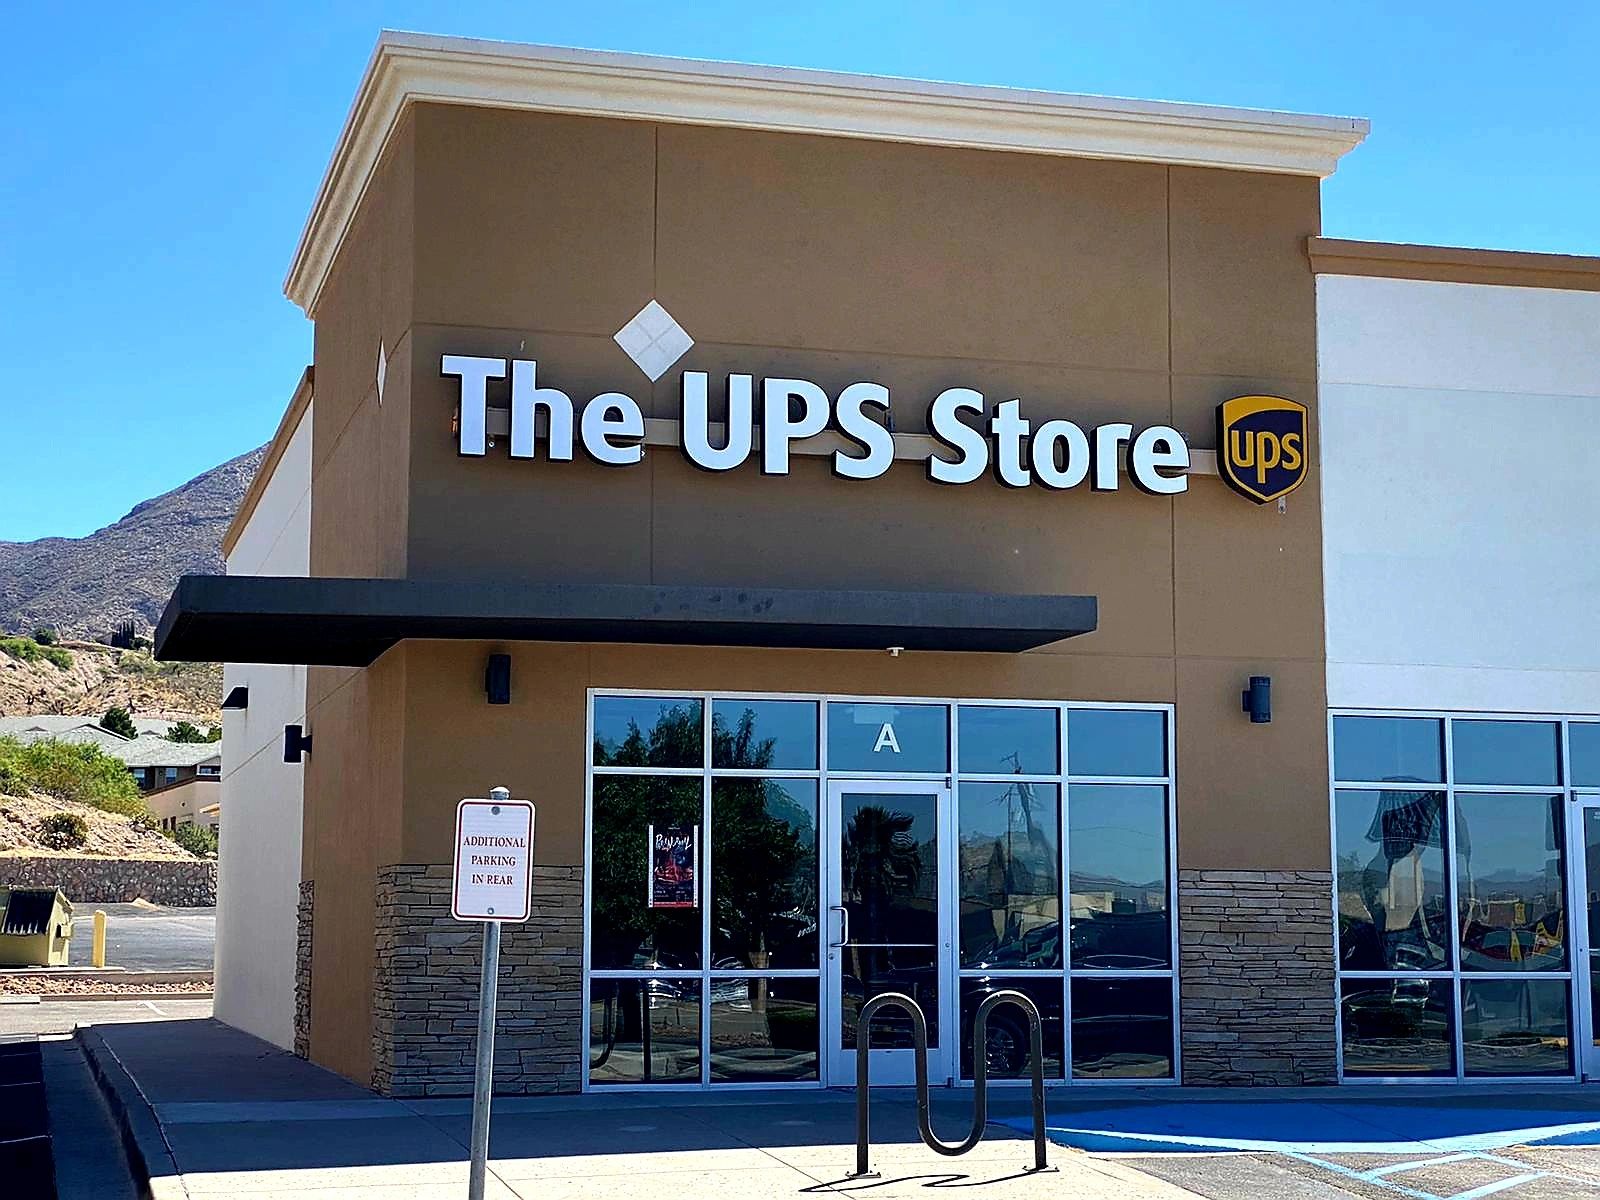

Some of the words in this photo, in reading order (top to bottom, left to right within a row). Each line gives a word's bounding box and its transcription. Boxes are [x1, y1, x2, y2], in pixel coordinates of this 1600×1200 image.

[441, 355, 645, 466] The
[681, 371, 895, 478] UPS
[926, 387, 1190, 494] Store
[1231, 430, 1302, 484] ups
[873, 723, 901, 753] A
[463, 836, 526, 848] ADDITIONAL
[471, 855, 516, 867] PARKING
[471, 874, 484, 885] IN
[486, 874, 513, 885] REAR
